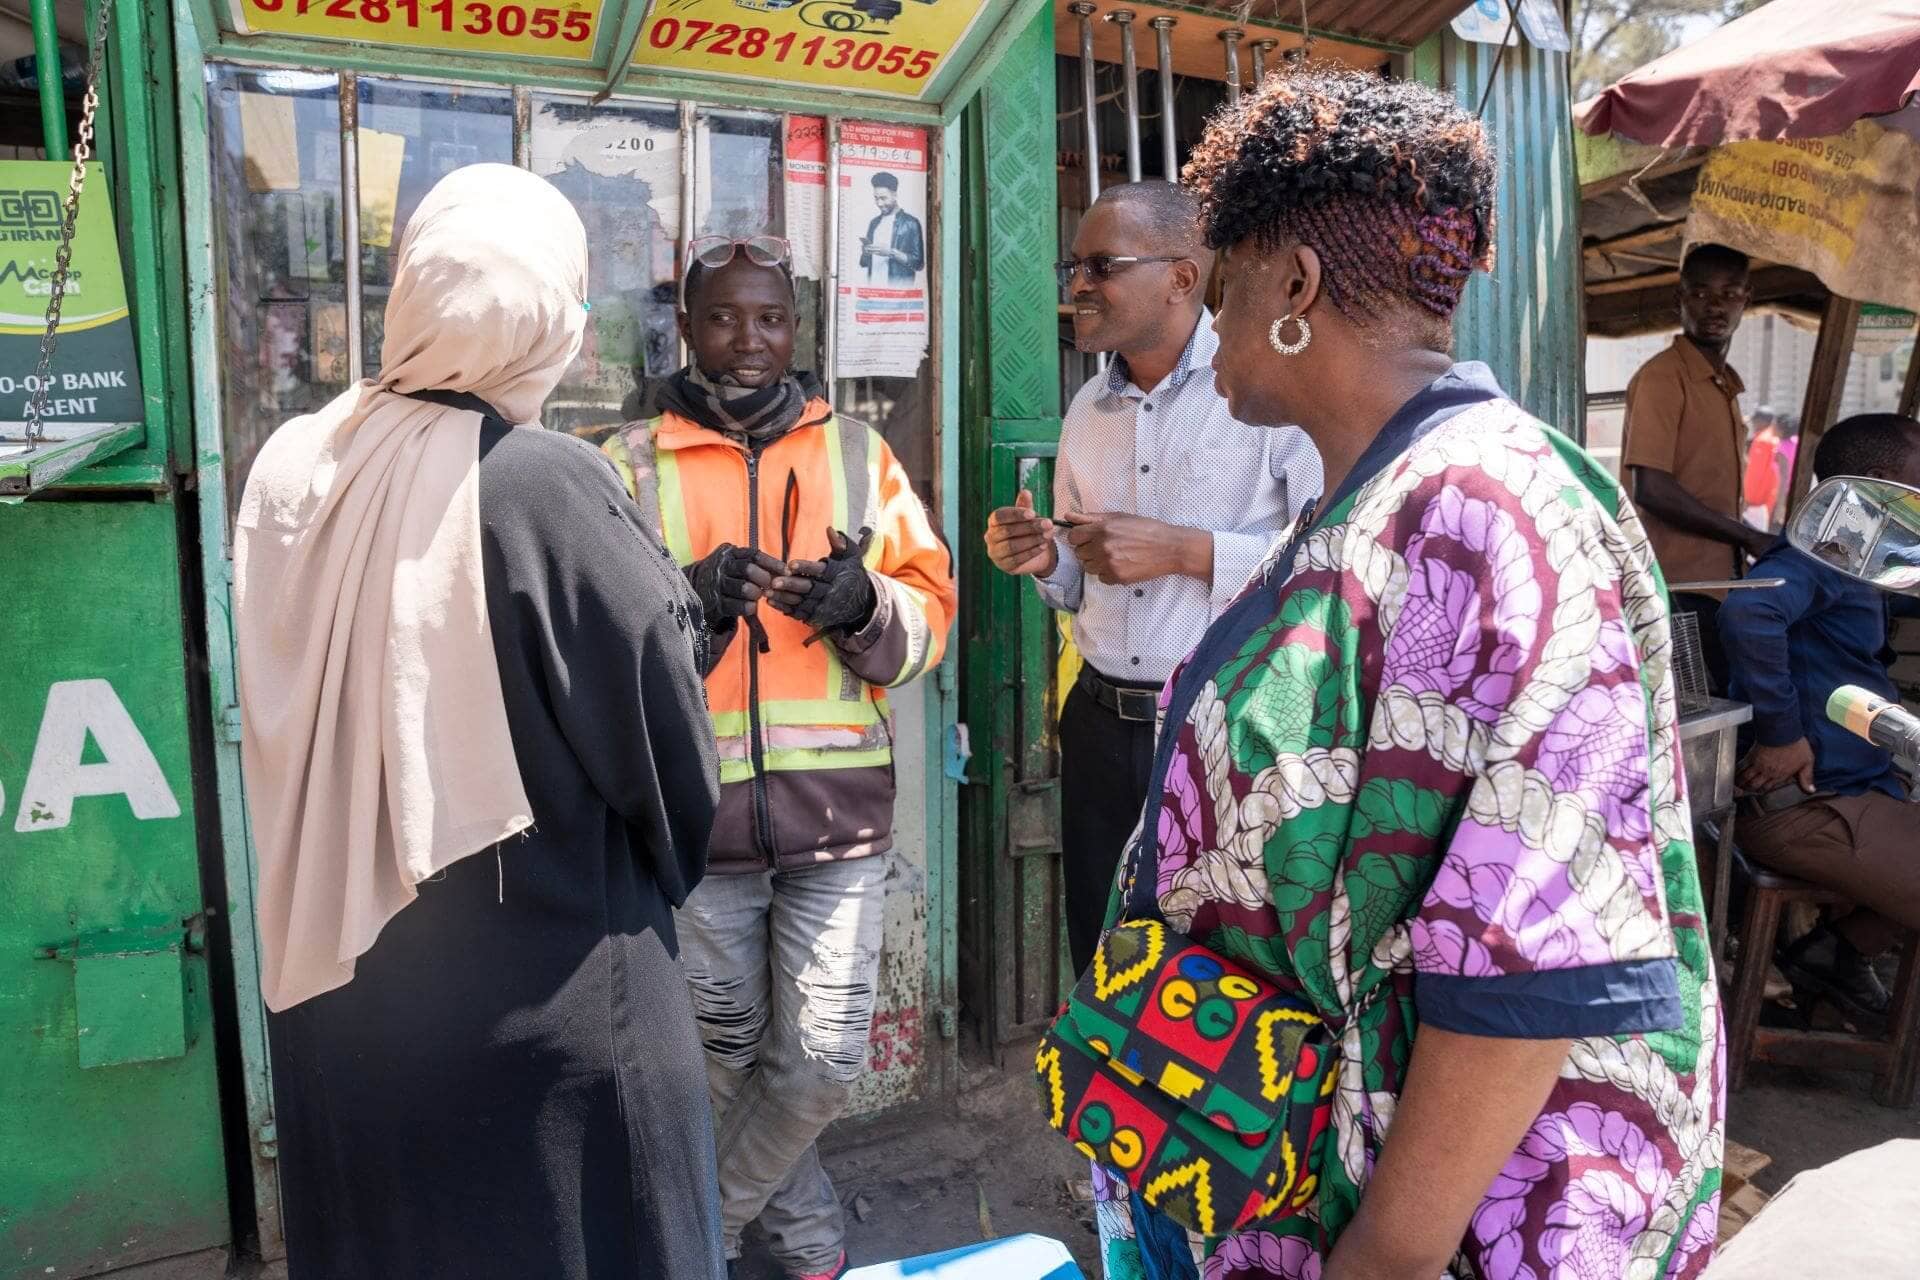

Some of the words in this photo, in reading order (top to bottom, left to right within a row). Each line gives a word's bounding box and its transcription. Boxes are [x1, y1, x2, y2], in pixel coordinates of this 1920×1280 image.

[649, 18, 940, 79] 0728113055
[605, 138, 655, 152] 200
[1695, 180, 1755, 206] MIDNIM
[1760, 191, 1807, 215] RADIO
[23, 279, 81, 294] Cah
[62, 370, 127, 390] BANK
[22, 397, 98, 418] AGENT
[0, 678, 181, 833] A
